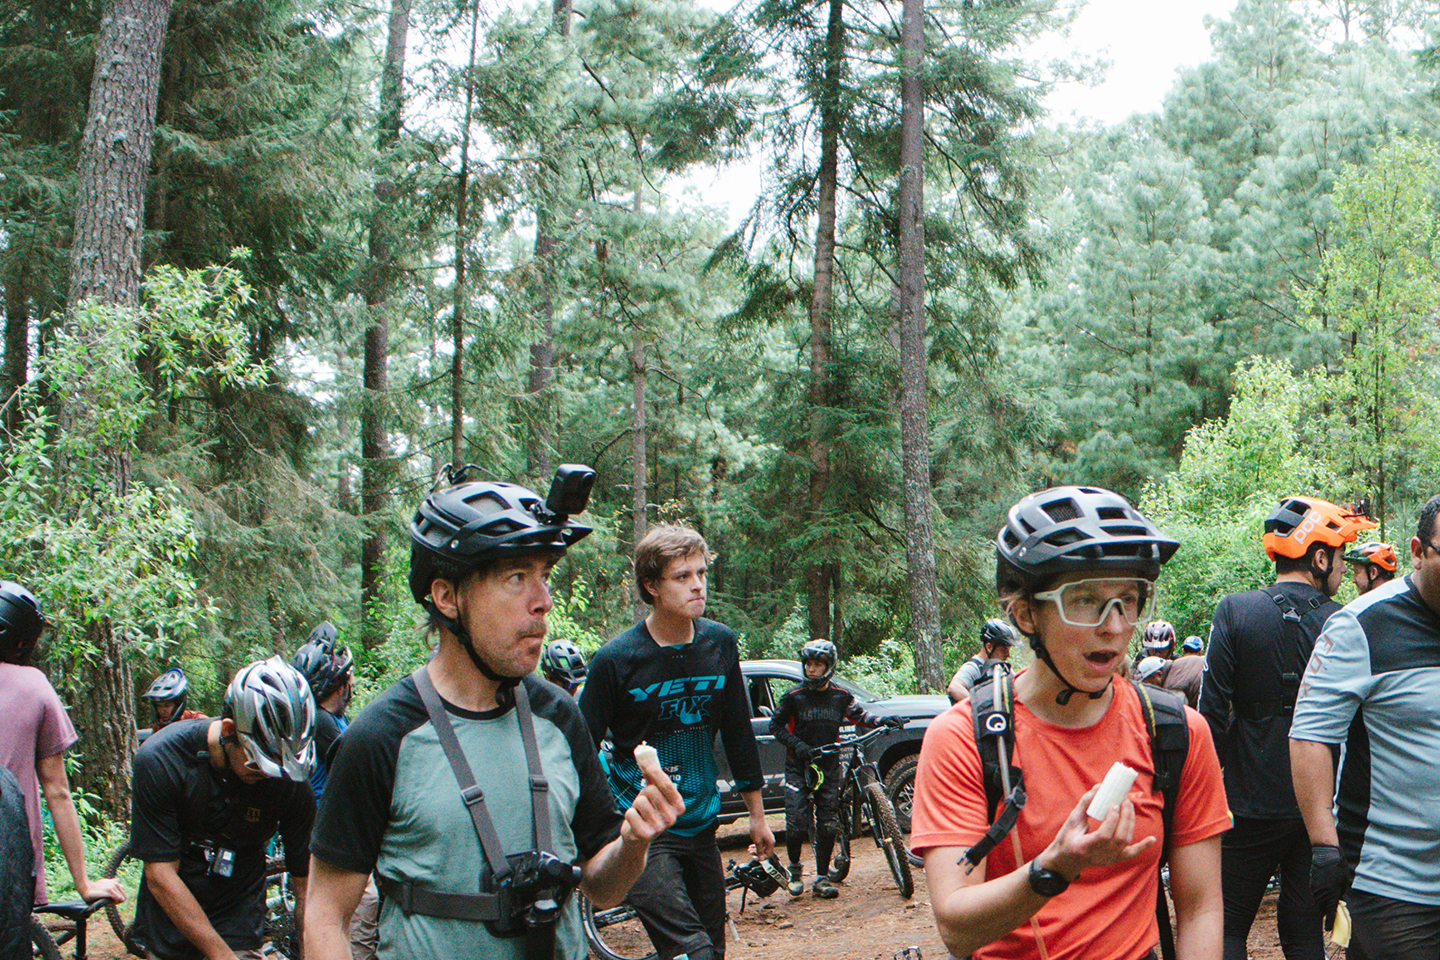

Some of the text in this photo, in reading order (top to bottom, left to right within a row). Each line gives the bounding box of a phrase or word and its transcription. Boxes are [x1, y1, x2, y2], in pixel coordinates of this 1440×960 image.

[1293, 511, 1322, 545] POC
[627, 674, 726, 702] YETI
[657, 694, 712, 725] FOX
